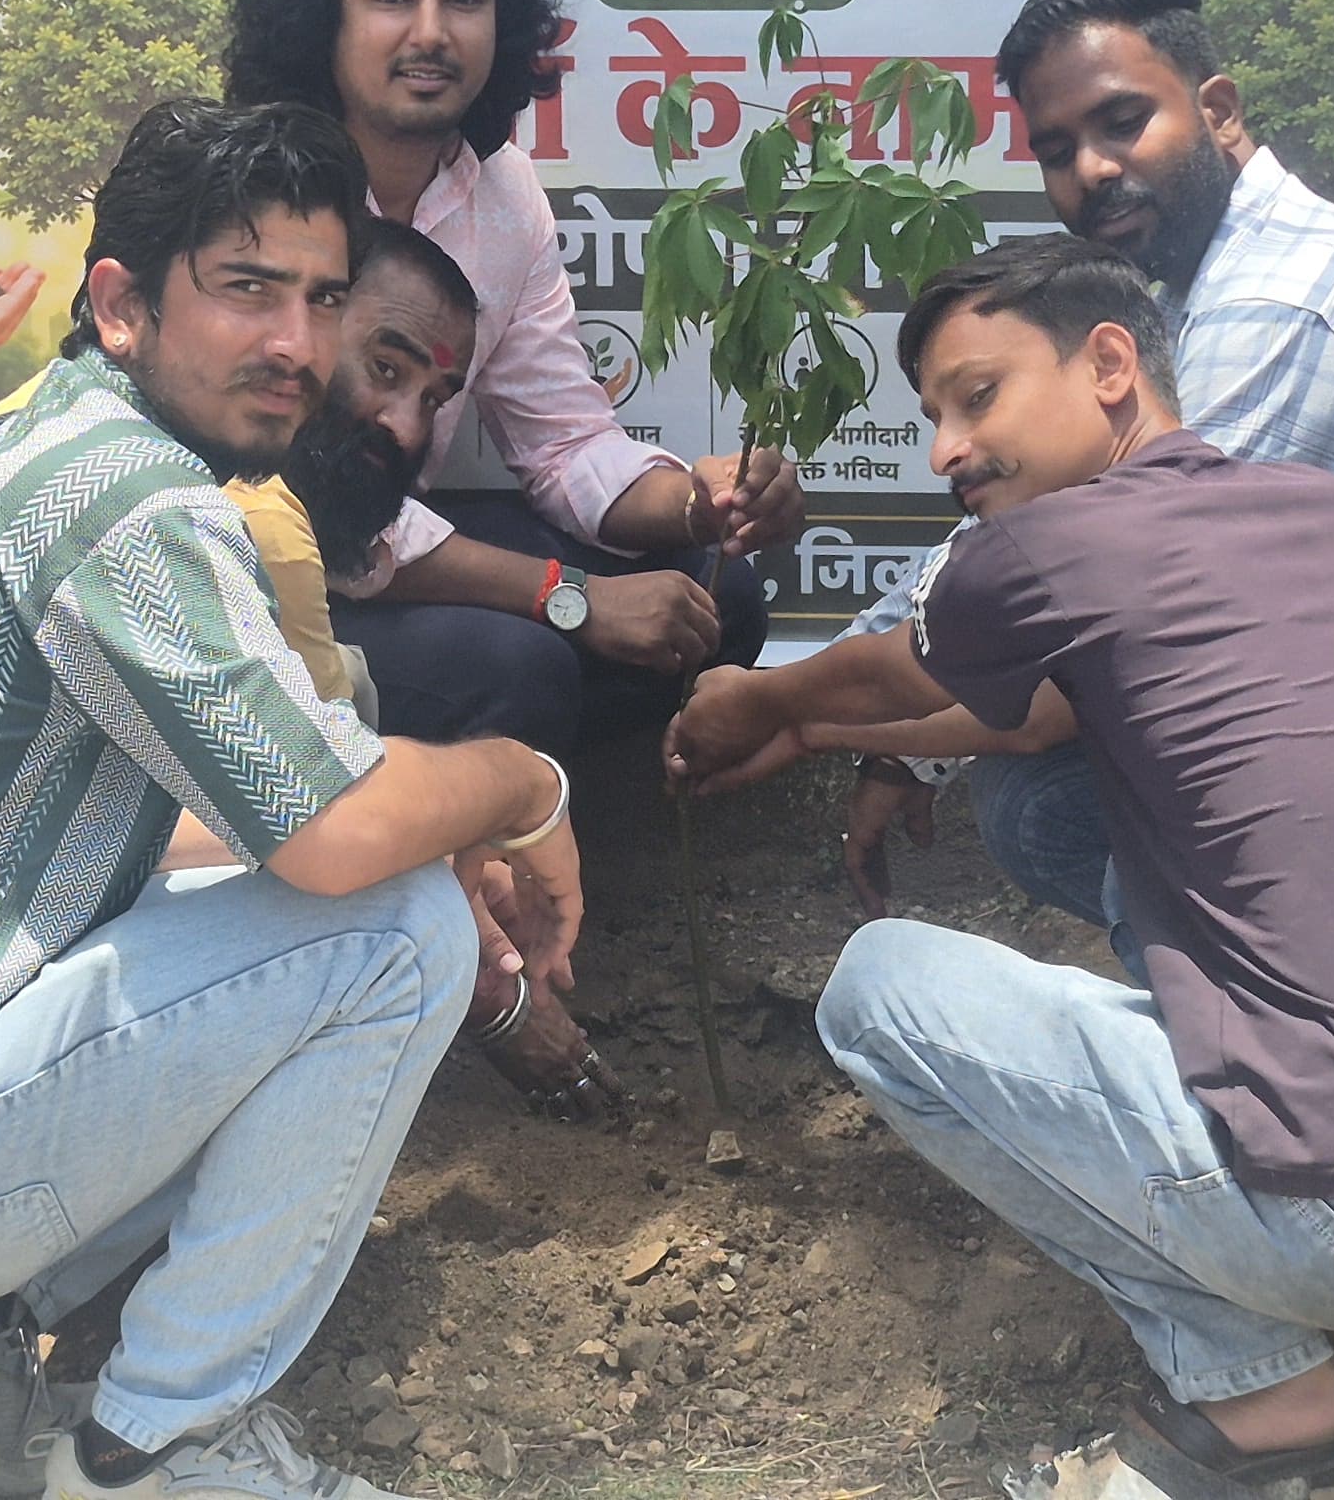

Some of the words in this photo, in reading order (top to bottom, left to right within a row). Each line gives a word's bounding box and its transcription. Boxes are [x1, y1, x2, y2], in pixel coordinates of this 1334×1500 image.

[609, 16, 746, 160] के
[831, 420, 920, 448] भागीदारी
[833, 455, 901, 481] भविष्य
